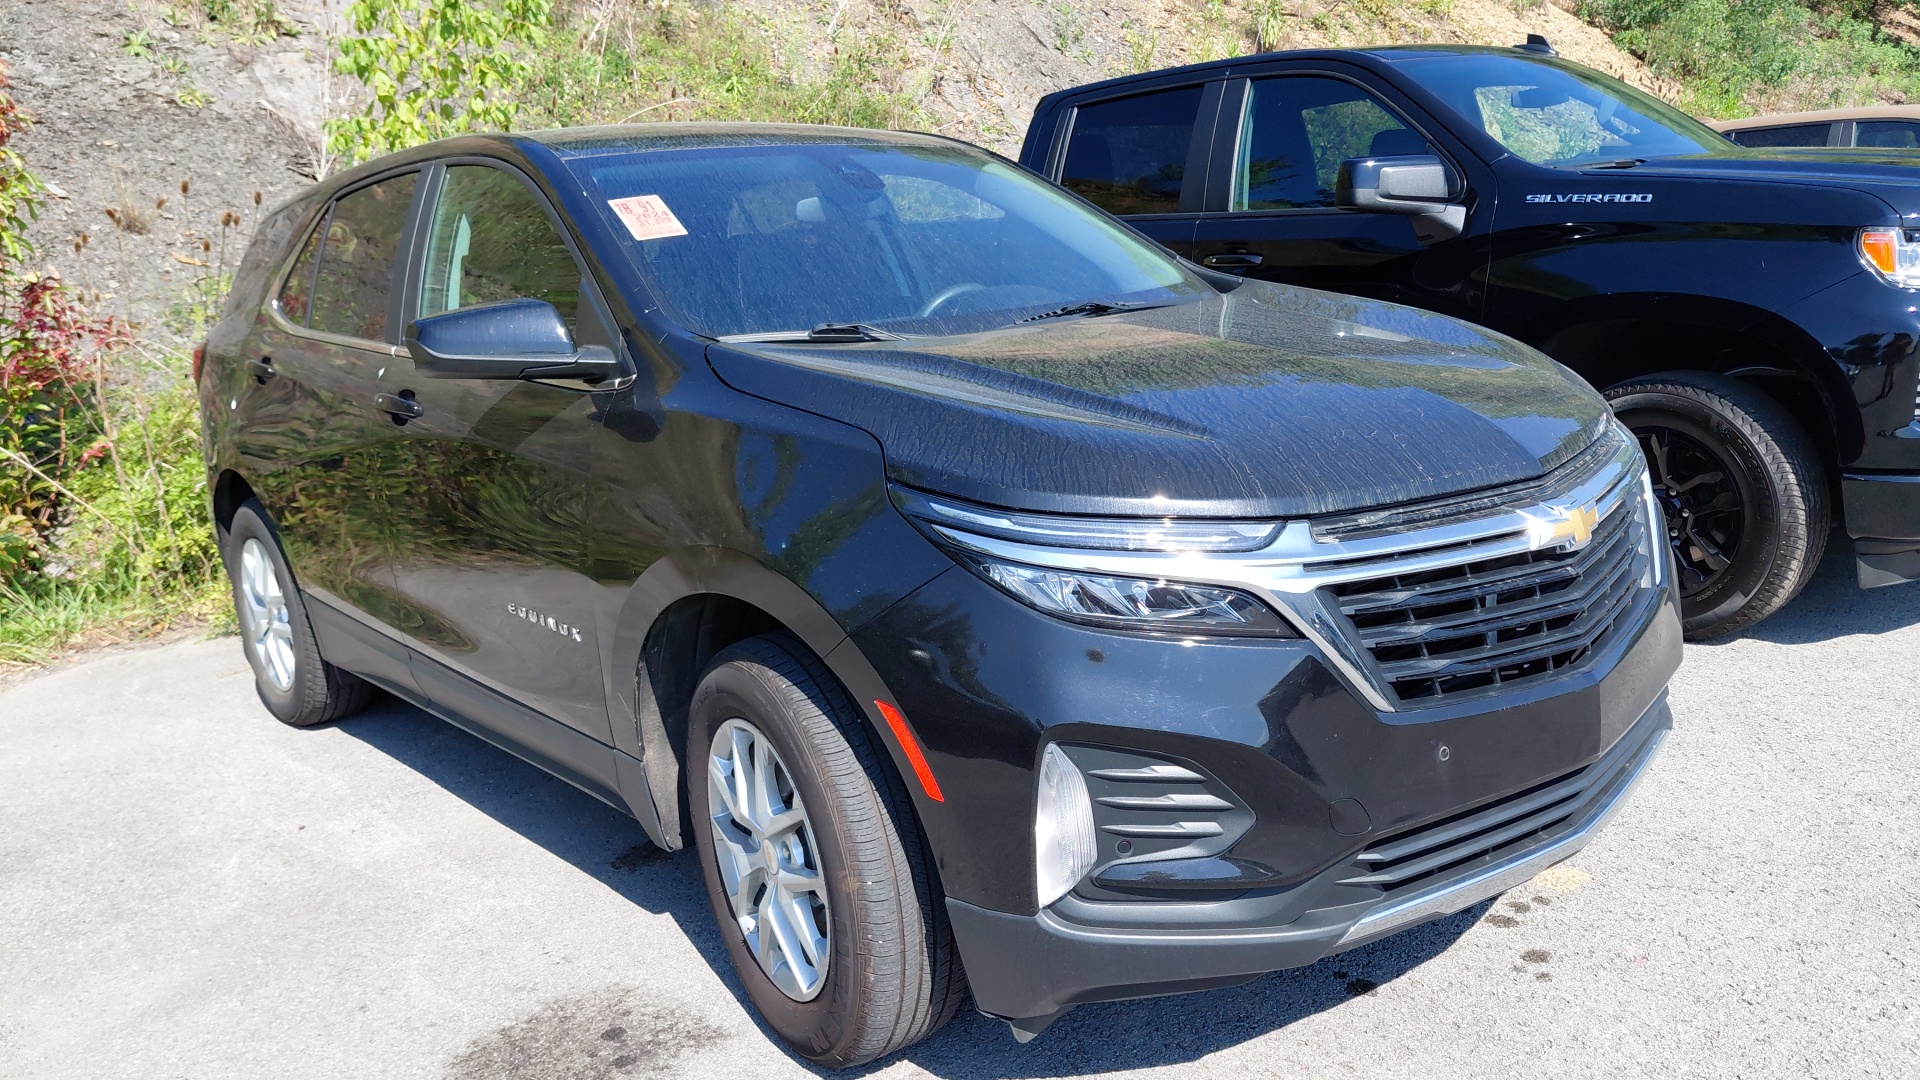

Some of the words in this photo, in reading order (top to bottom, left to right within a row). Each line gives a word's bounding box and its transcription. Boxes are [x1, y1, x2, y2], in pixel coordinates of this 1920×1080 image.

[1525, 193, 1653, 204] SILVERADO
[637, 200, 656, 213] 91
[633, 210, 669, 220] 2024
[507, 602, 582, 642] EQUINOX
